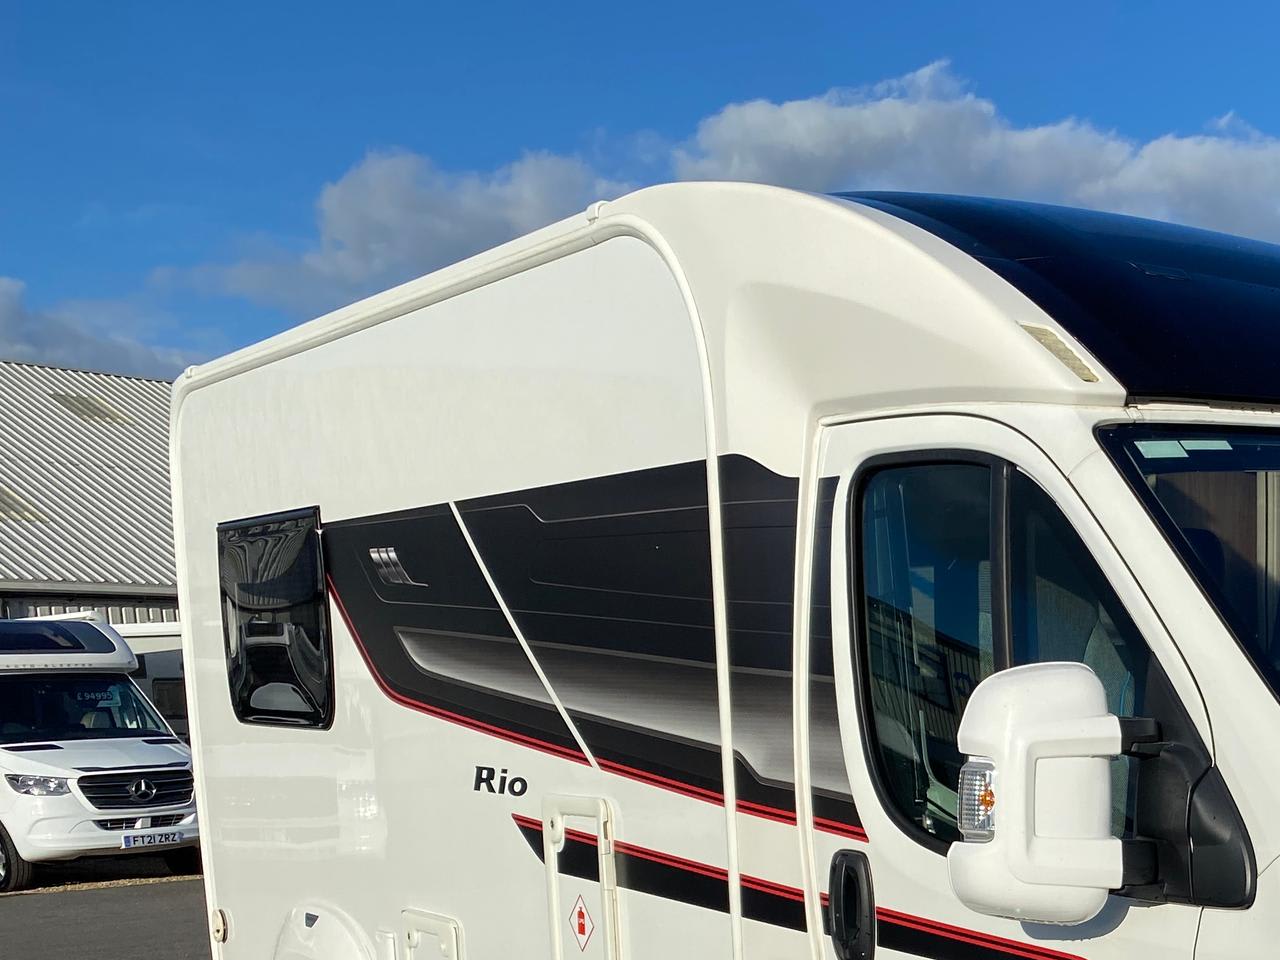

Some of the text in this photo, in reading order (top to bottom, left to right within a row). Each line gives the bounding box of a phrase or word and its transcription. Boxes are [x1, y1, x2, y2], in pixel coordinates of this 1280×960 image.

[473, 765, 528, 797] Rio
[133, 832, 177, 845] FT21 ZRZ
